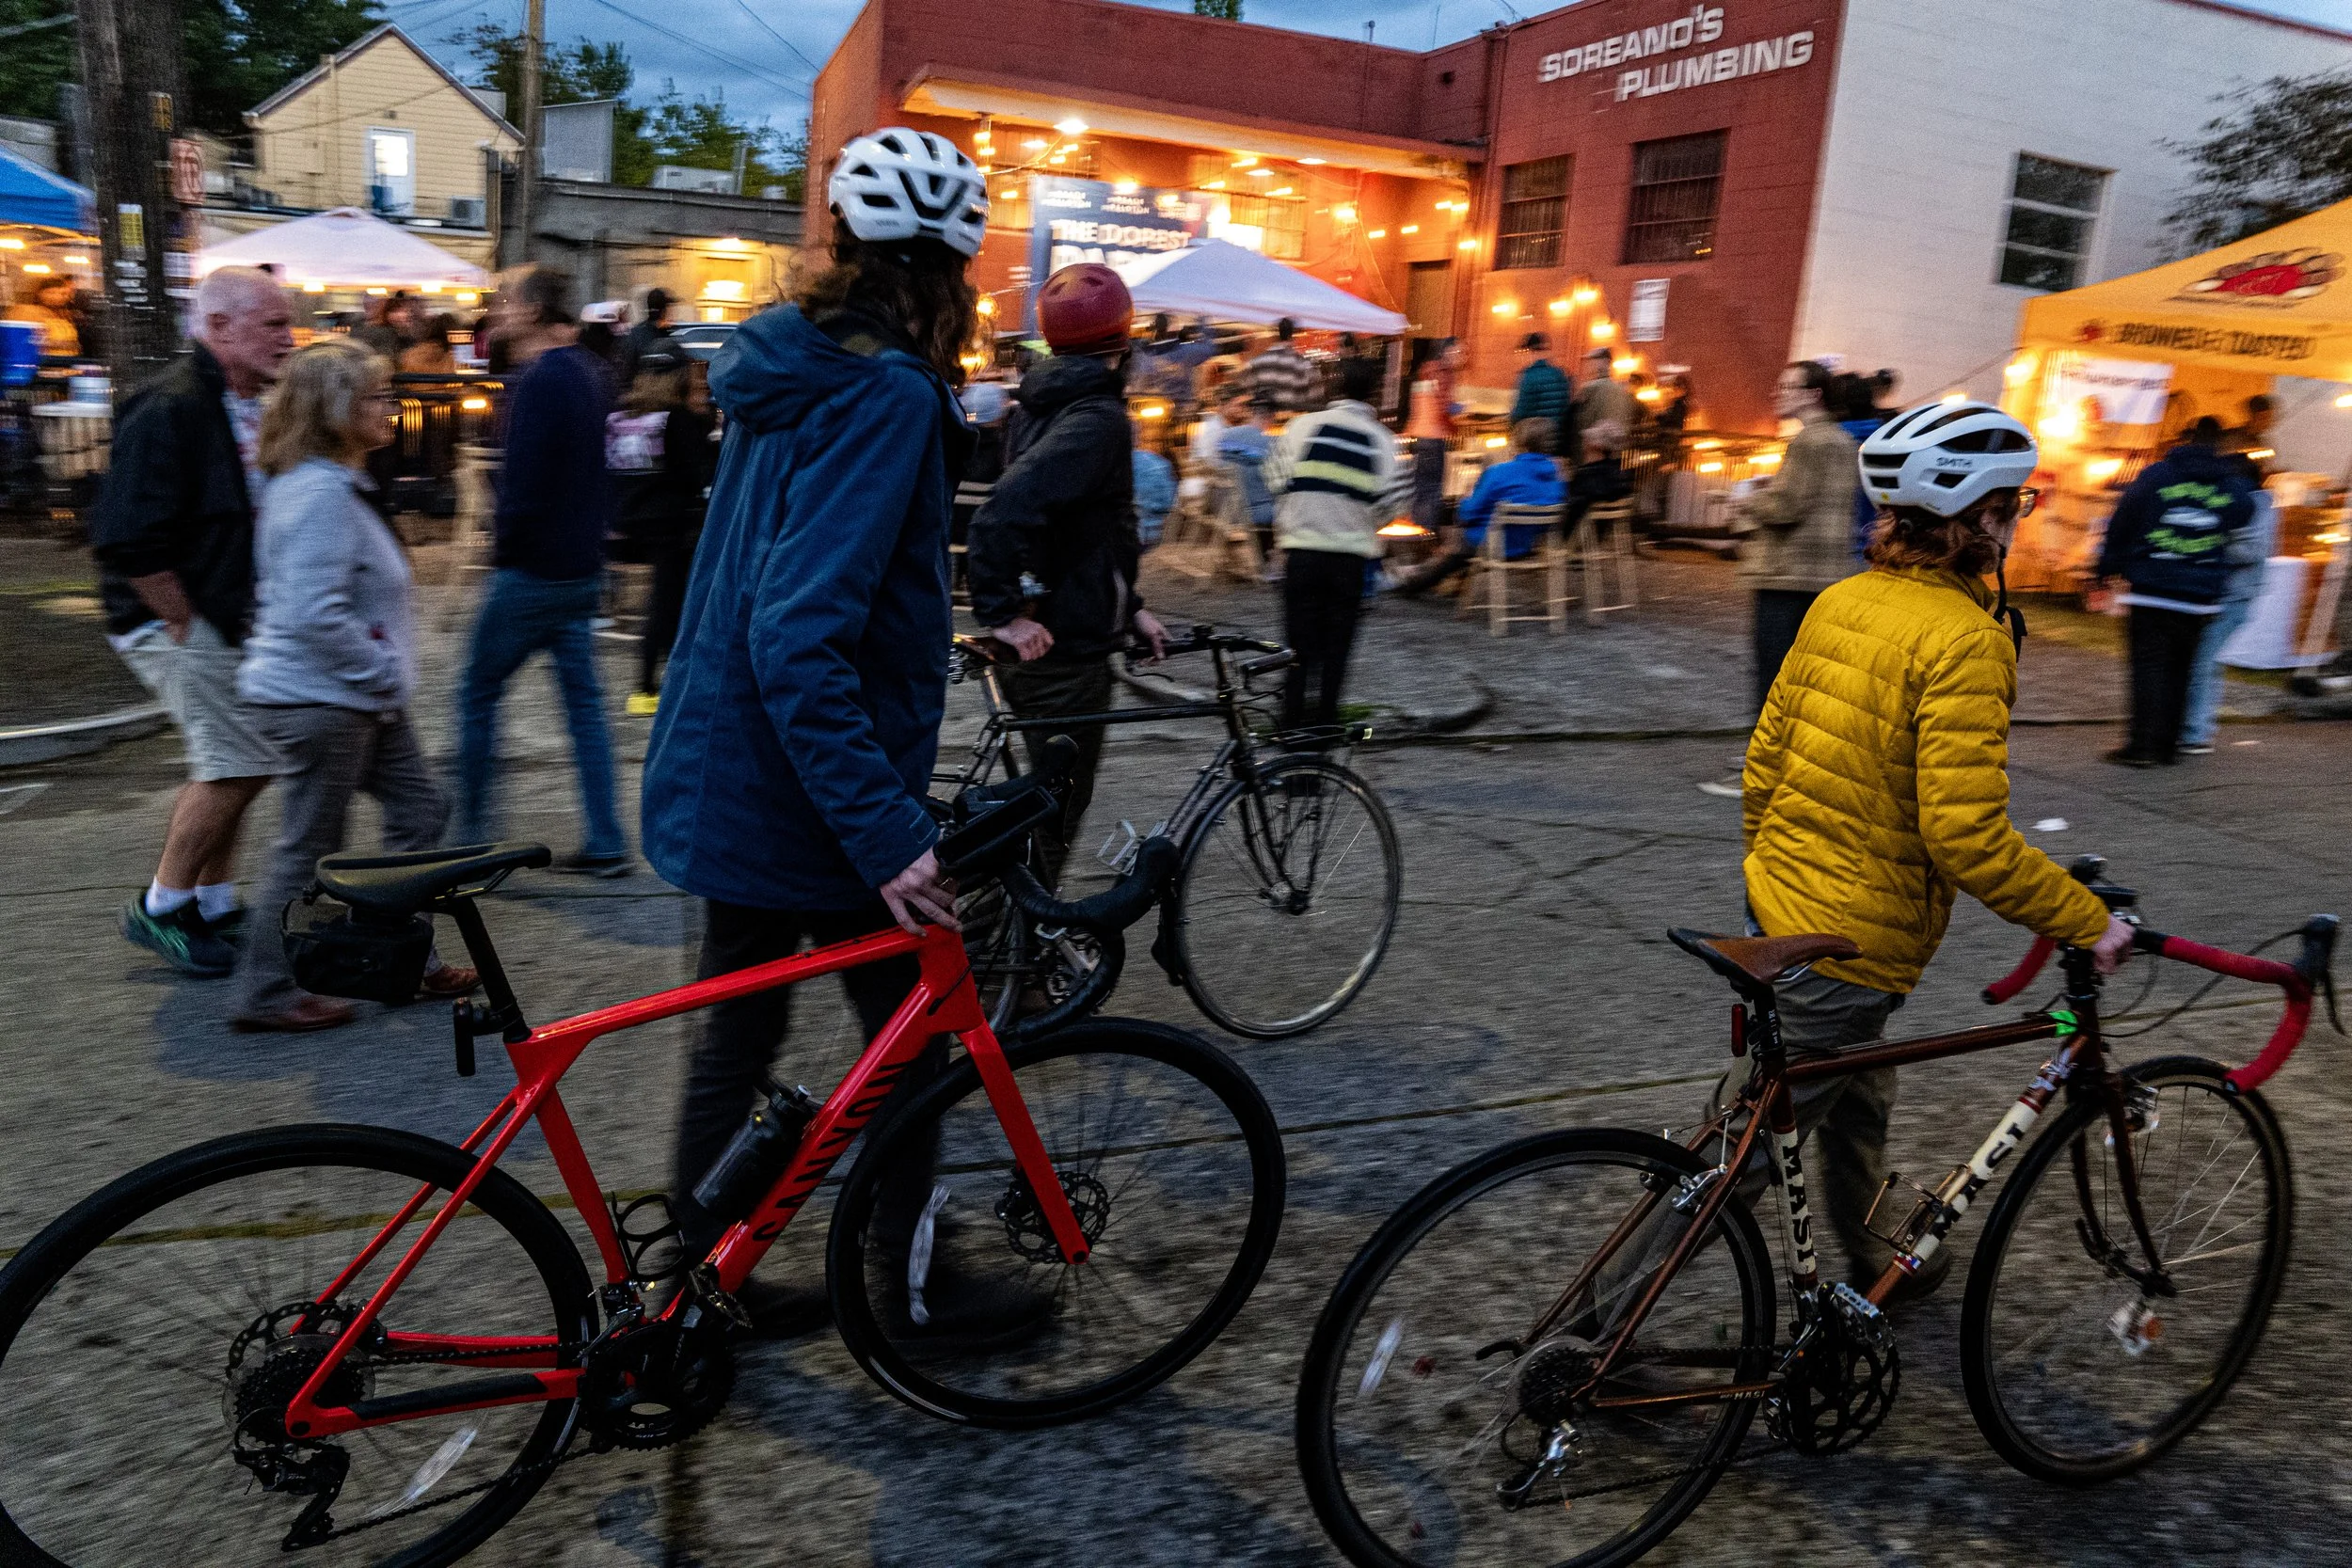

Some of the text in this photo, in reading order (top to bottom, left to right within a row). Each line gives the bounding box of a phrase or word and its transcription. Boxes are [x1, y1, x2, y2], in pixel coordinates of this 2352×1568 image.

[1539, 5, 1724, 83] SOREANO'S
[1613, 31, 1814, 103] PLUMBING
[1049, 219, 1098, 243] THE
[1783, 1144, 1814, 1262] MASI
